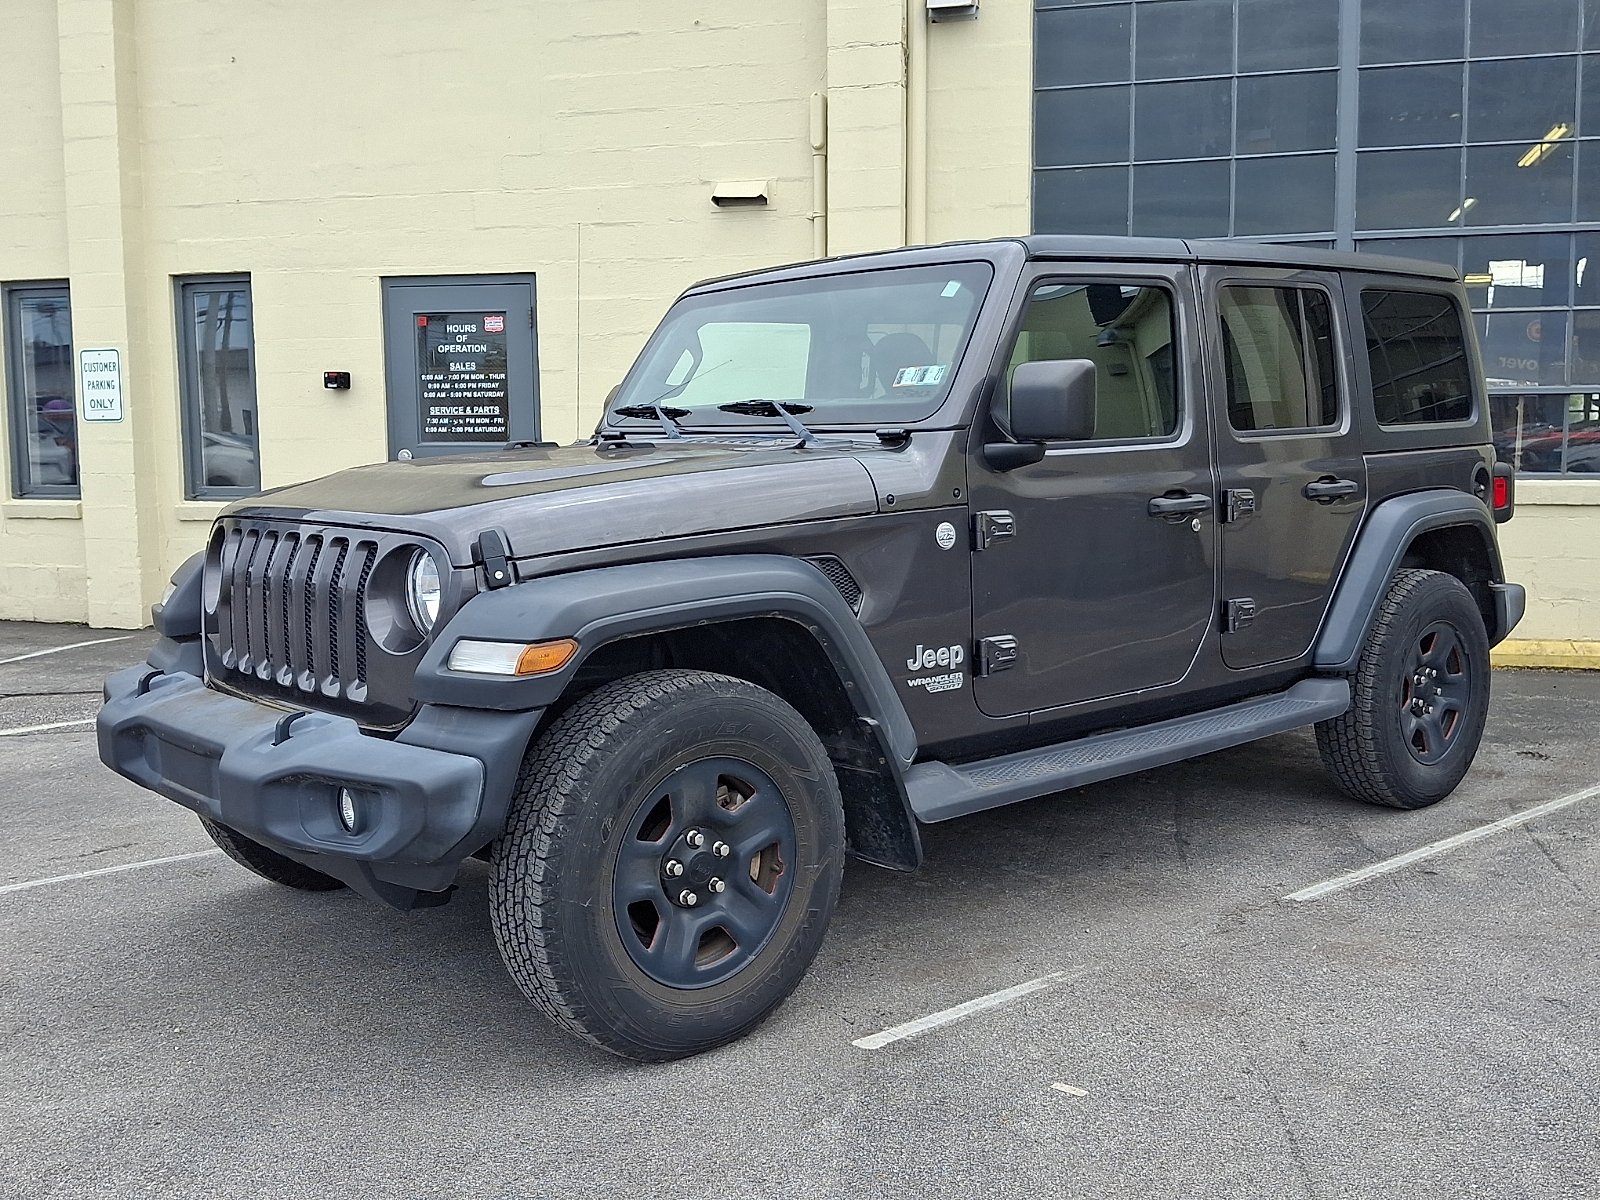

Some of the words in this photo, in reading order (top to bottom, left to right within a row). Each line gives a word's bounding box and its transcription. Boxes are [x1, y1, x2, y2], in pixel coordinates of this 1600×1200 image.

[446, 324, 476, 333] HOURS
[438, 345, 487, 353] OPERATION
[84, 362, 116, 372] CUSTOMER
[450, 362, 476, 370] SALES
[88, 380, 115, 390] PARKING
[90, 399, 114, 409] ONLY
[430, 407, 464, 415] SERVICE
[466, 406, 471, 414] &
[473, 406, 500, 414] PARTS
[907, 645, 964, 671] Jeep
[907, 672, 963, 687] WRANGLER
[929, 683, 961, 691] SPORT
